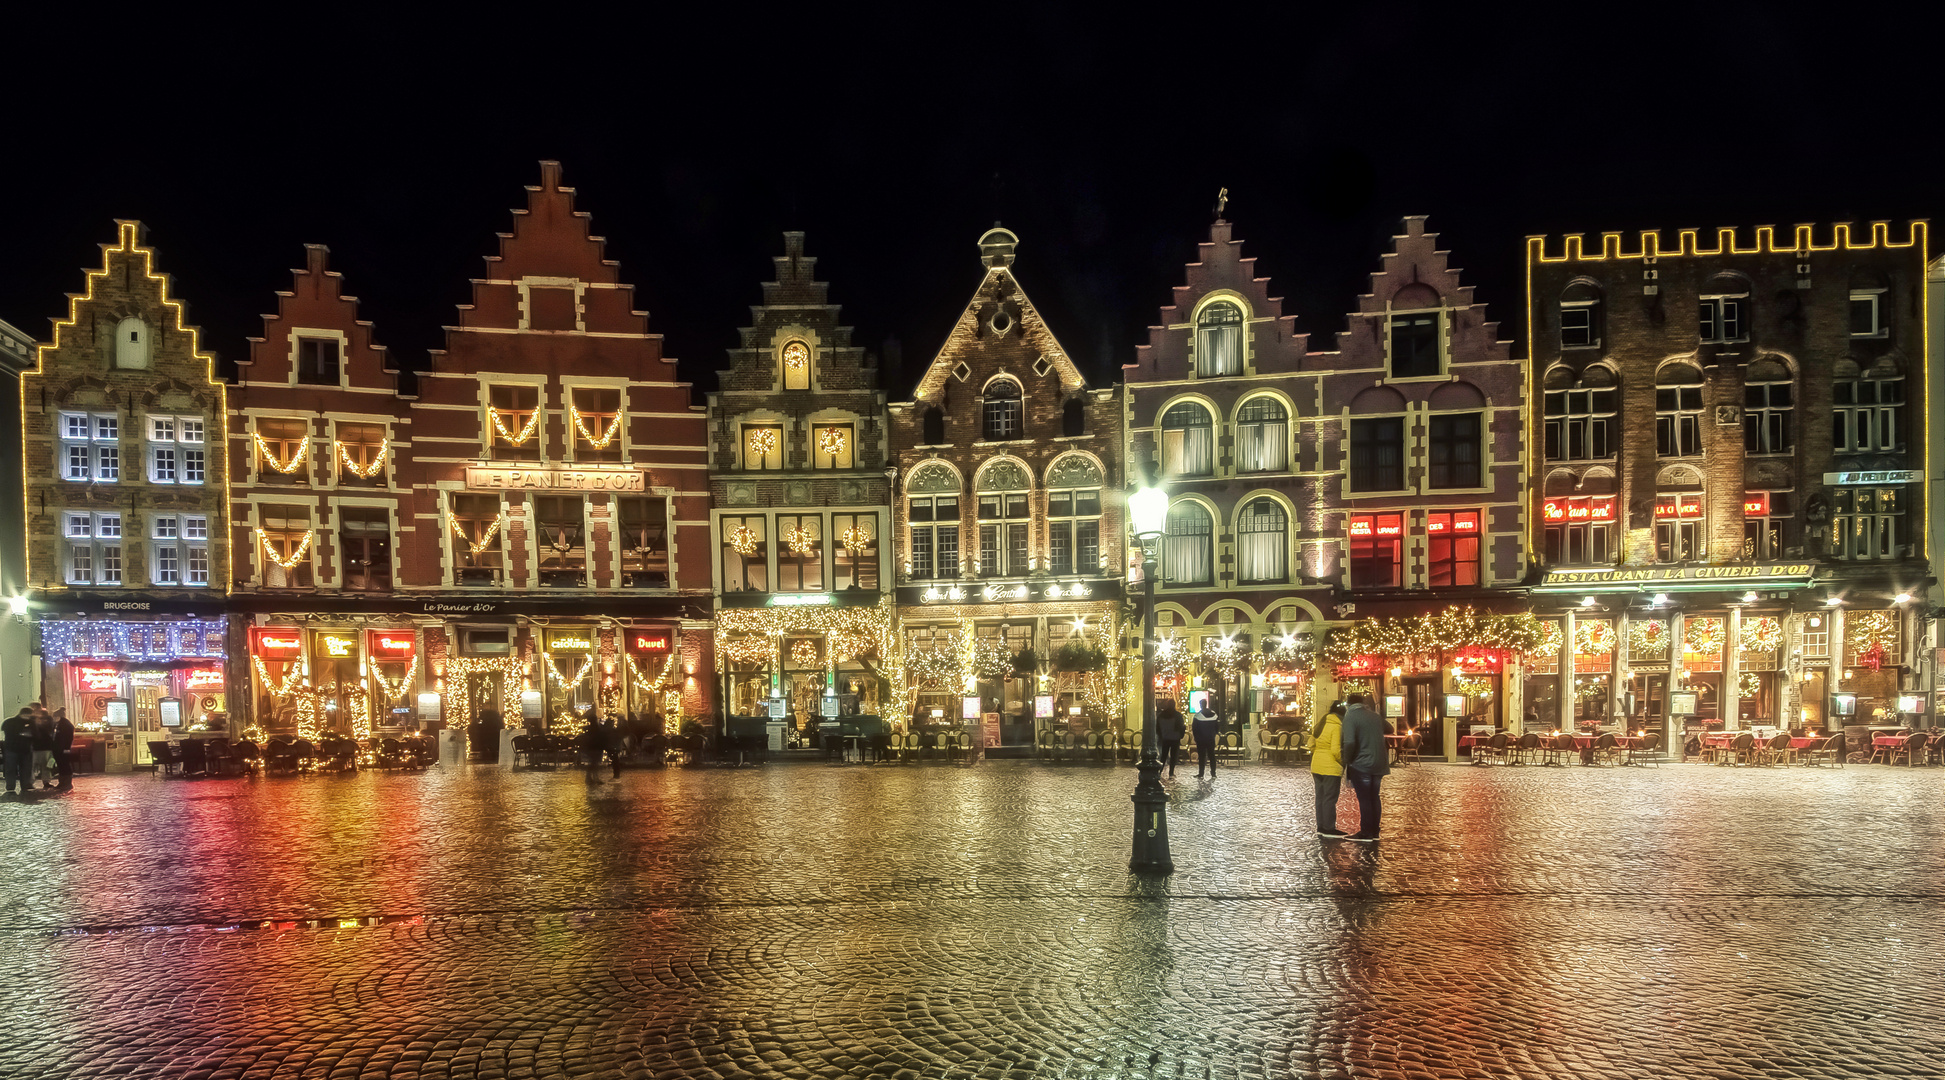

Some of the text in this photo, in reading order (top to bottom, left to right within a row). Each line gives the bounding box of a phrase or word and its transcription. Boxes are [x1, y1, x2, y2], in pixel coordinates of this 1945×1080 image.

[475, 470, 641, 490] LE PANIER D'OR
[1428, 521, 1474, 531] DES ARTS
[1546, 564, 1810, 584] RESTAURANT LA CIVIERE D'OR
[983, 584, 1027, 602] Centra
[1043, 584, 1093, 599] rasrie
[103, 602, 151, 611] BRUGEOISE
[423, 602, 496, 612] Le Panier d'Or
[637, 637, 666, 649] Duvel
